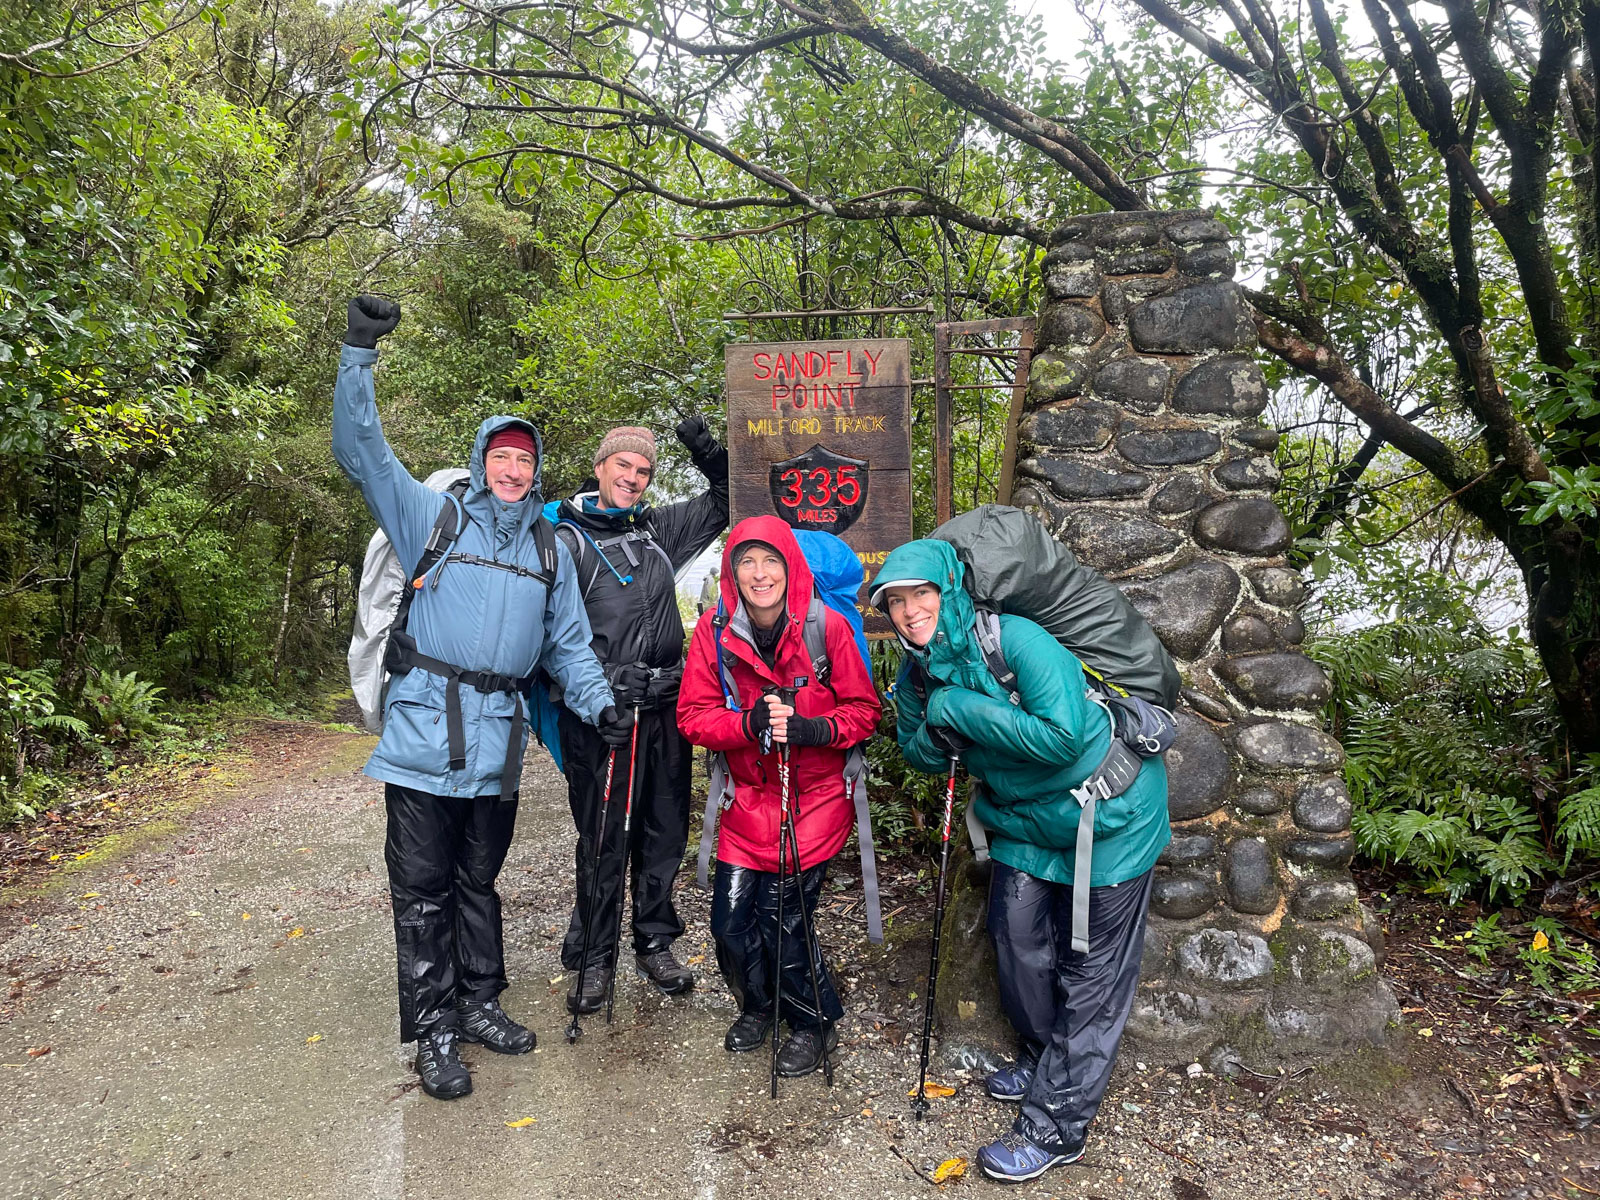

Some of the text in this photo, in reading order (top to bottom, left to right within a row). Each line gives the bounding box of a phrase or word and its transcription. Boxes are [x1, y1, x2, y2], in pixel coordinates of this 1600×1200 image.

[753, 349, 884, 380] SANDFLY
[772, 382, 861, 411] POINT
[747, 414, 887, 437] MILFORD TRACK
[797, 509, 838, 523] MILES
[781, 764, 789, 812] FIZAN
[943, 787, 953, 836] FIZAN
